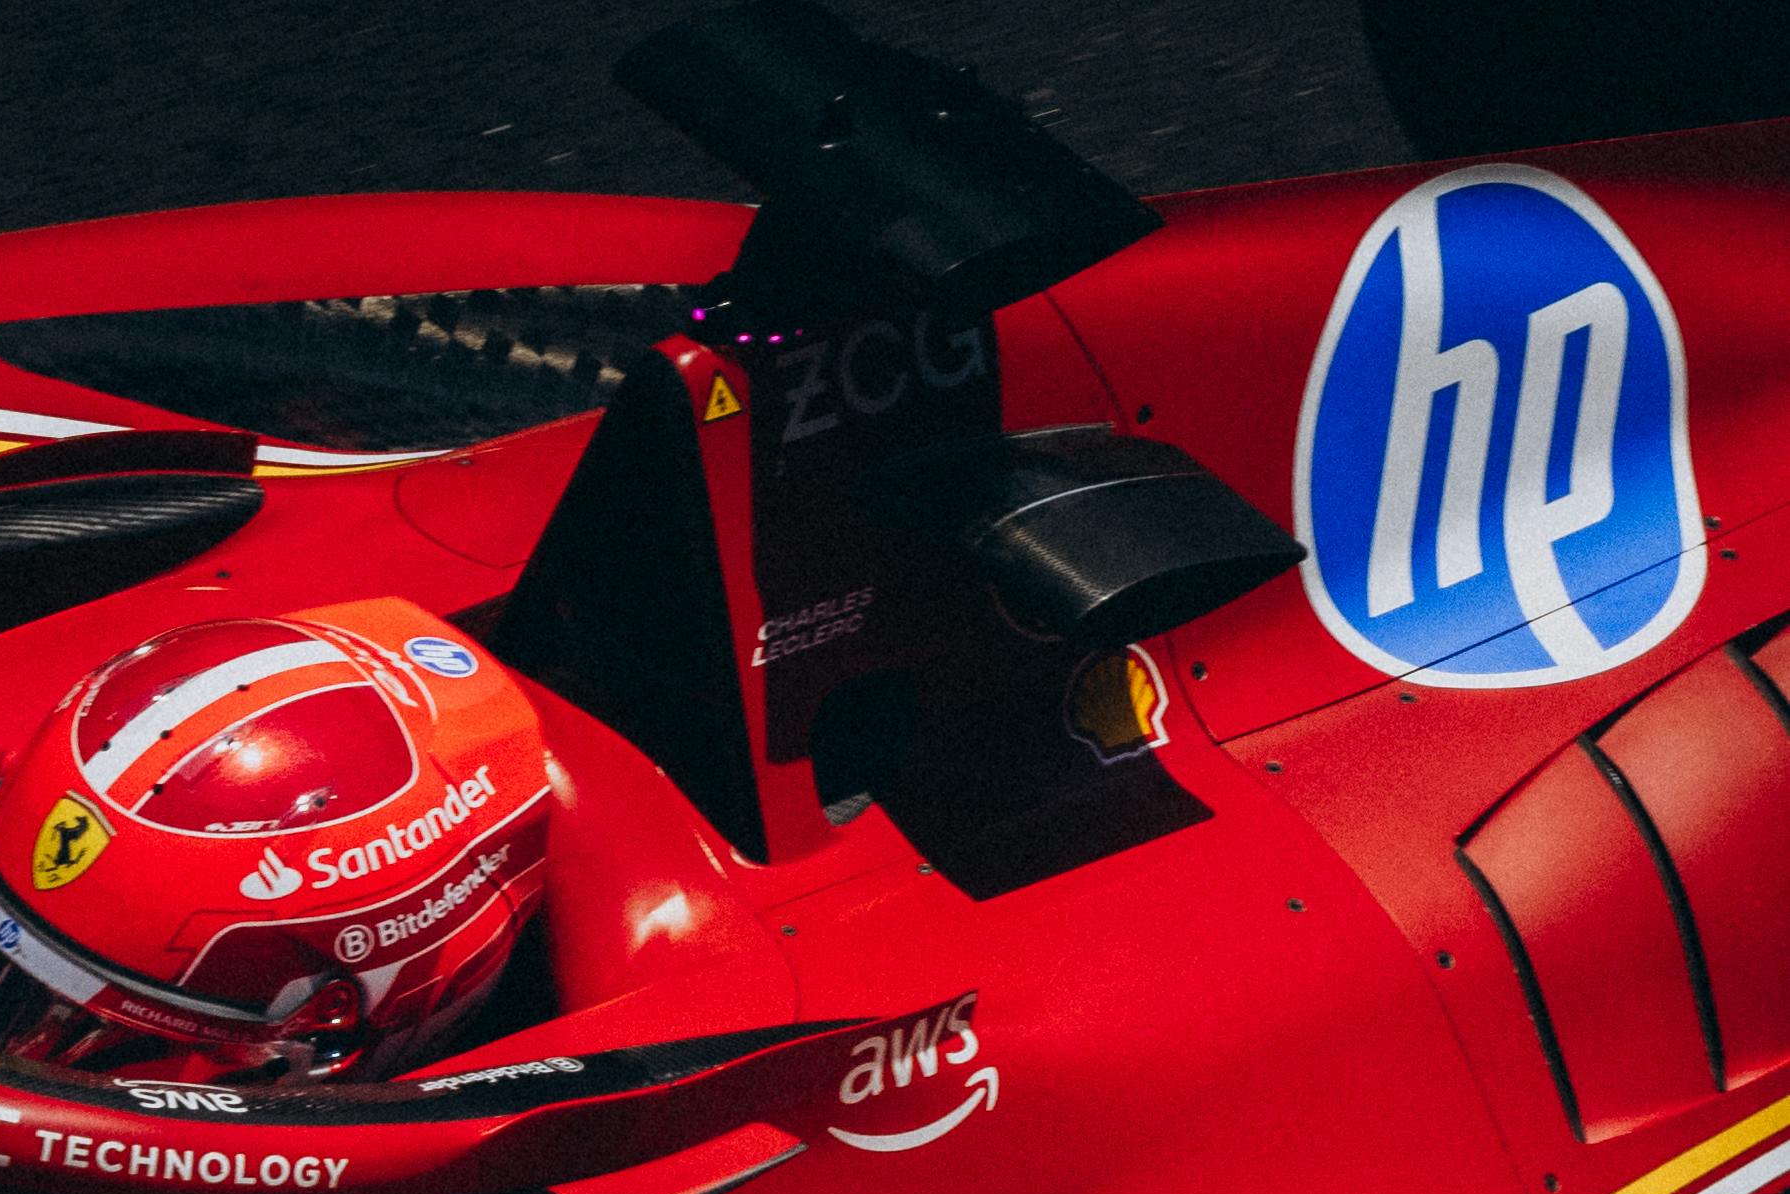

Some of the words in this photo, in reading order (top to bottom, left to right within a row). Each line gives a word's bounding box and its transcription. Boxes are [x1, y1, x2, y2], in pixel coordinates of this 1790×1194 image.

[1367, 195, 1629, 668] hp
[751, 612, 867, 667] LECLERC
[756, 585, 877, 641] CHARLES
[306, 764, 497, 890] Santander
[375, 843, 511, 947] Bitdefender
[119, 999, 199, 1034] RICHARD
[417, 1061, 556, 1092] Bitdefender
[838, 992, 980, 1105] aws
[33, 1129, 350, 1189] TECHNOLOGY
